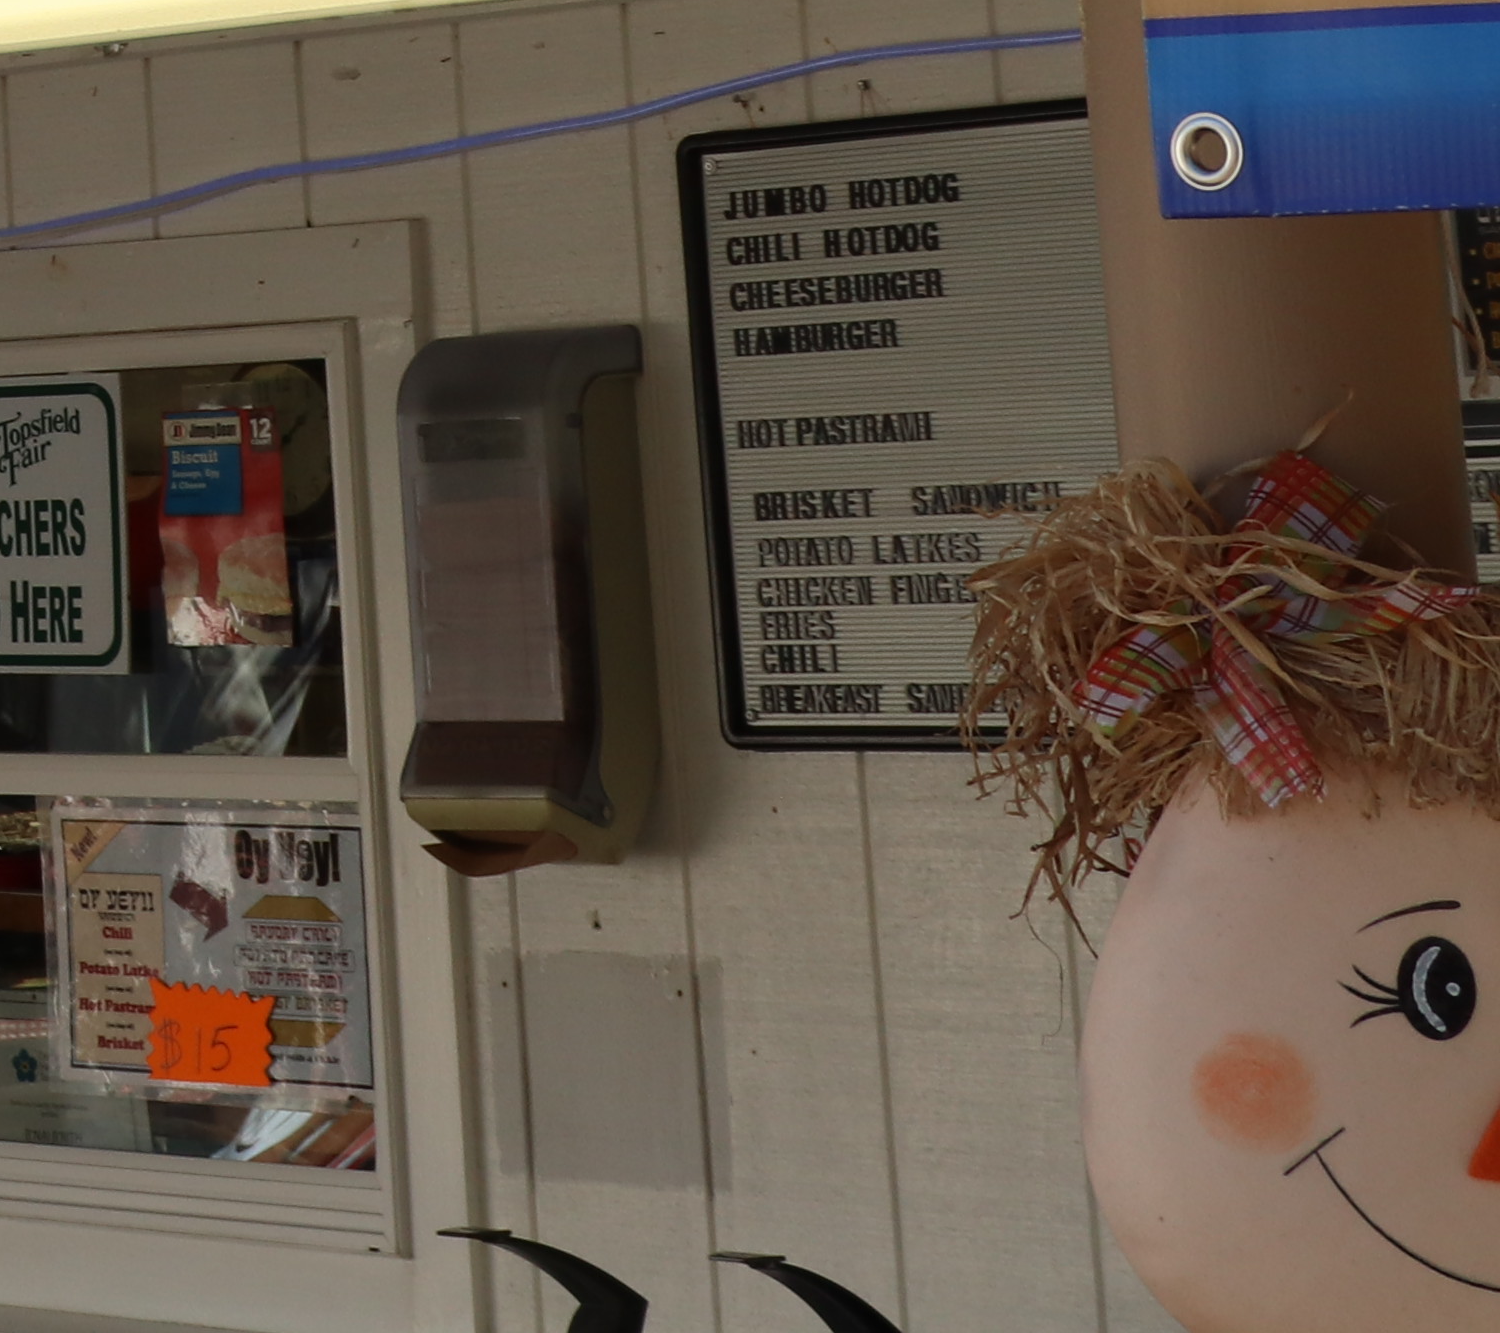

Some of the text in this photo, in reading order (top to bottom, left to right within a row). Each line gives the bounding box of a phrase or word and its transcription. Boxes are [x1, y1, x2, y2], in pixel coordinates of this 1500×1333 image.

[724, 173, 961, 221] JUMBO HOTDOG
[726, 232, 802, 266] CHILI
[729, 268, 946, 312] CHEESEBURGER
[733, 318, 900, 357] HAMBURGER
[249, 417, 273, 440] 12
[737, 411, 934, 449] HOT PASTRAMI
[171, 450, 219, 465] Biscuit
[754, 488, 873, 522] BRISKET
[757, 532, 982, 568] POTATO LATKES
[756, 574, 874, 608] CHICKEN
[10, 580, 84, 644] HERE
[760, 610, 836, 641] FRIES
[760, 643, 840, 675] CHILI
[759, 684, 884, 715] BREAKFAST
[70, 826, 99, 863] New!
[235, 830, 340, 887] Oy Vey!
[102, 926, 134, 941] Chili
[79, 961, 160, 979] Potato Latke
[79, 997, 103, 1013] Hot
[97, 1035, 146, 1052] Brisket
[159, 1016, 239, 1076] $15
